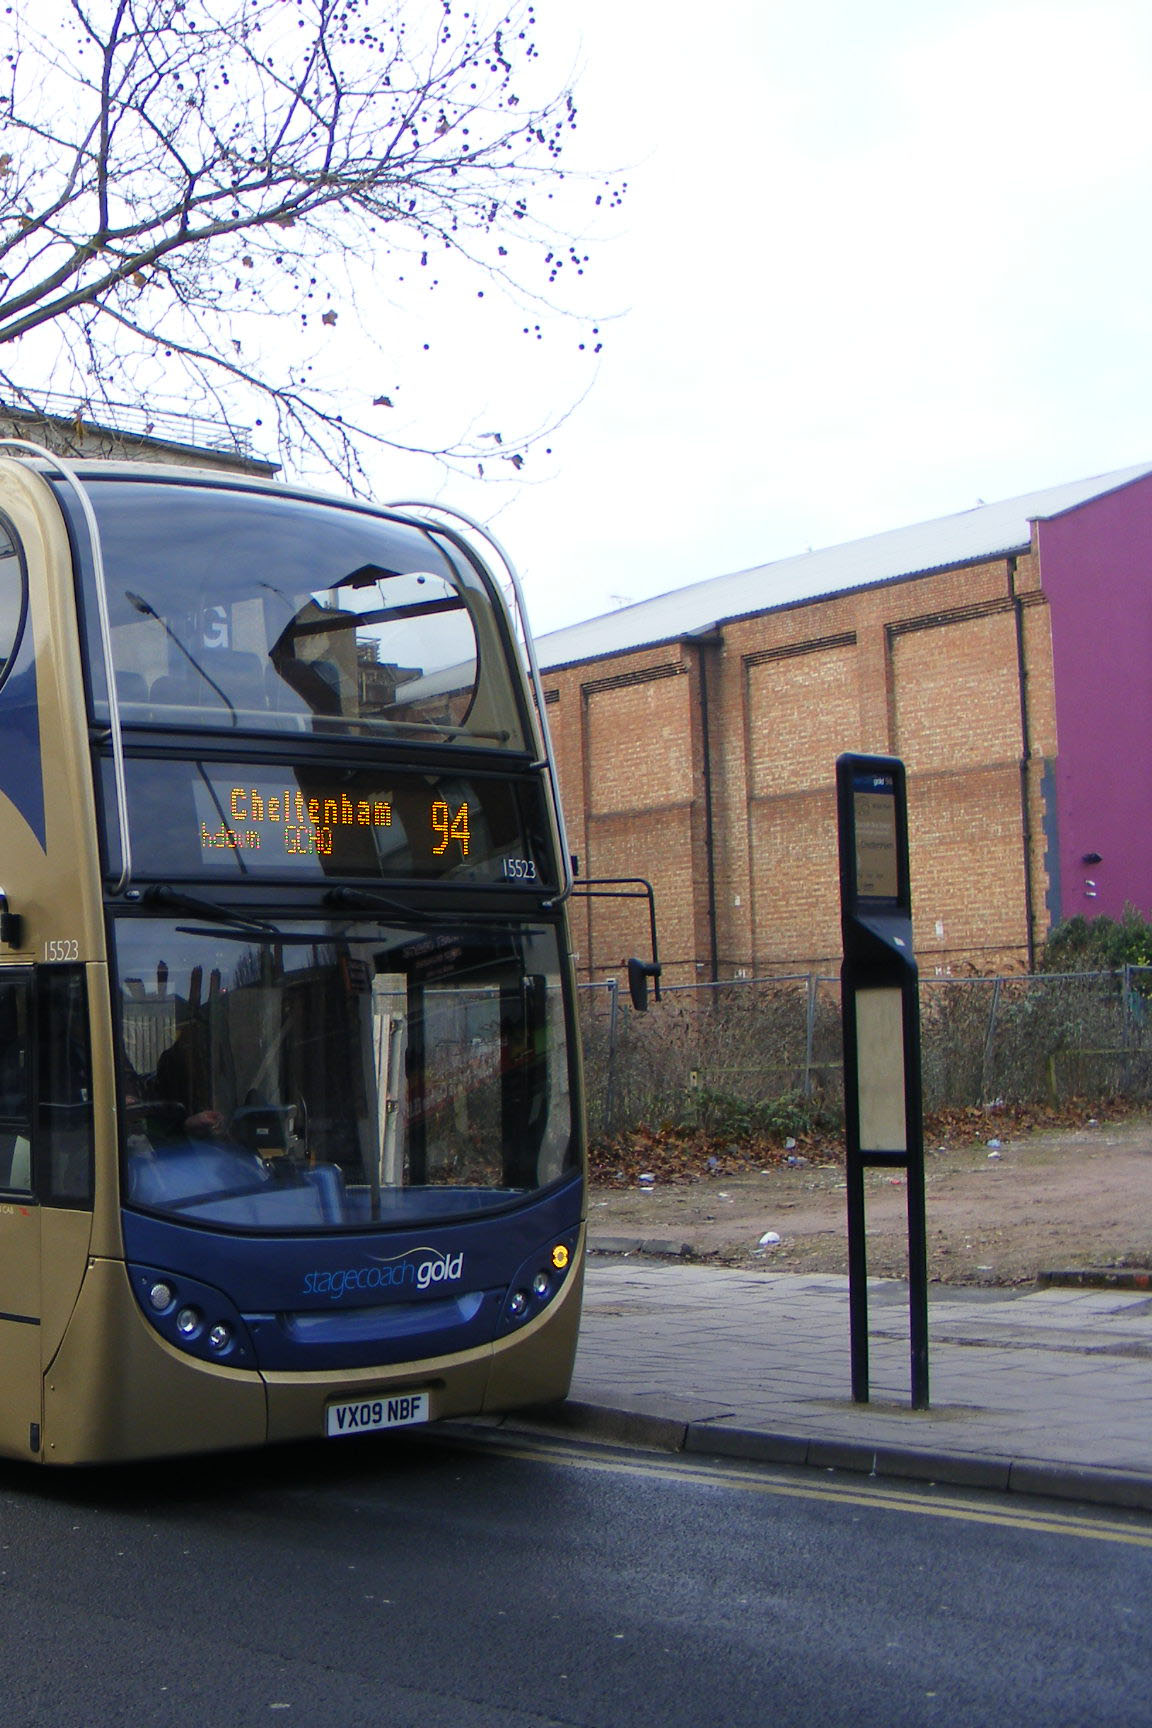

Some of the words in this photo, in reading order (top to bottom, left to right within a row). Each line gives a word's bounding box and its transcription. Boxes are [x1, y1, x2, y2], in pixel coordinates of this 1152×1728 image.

[231, 787, 392, 826] Cheltenham
[431, 801, 470, 855] 94
[284, 824, 333, 855] GCHQ
[503, 858, 537, 879] 15523
[44, 940, 79, 961] 15523
[303, 1260, 415, 1299] stagecoach
[416, 1252, 464, 1289] gold
[336, 1402, 383, 1430] VX09
[387, 1396, 422, 1422] NBF
